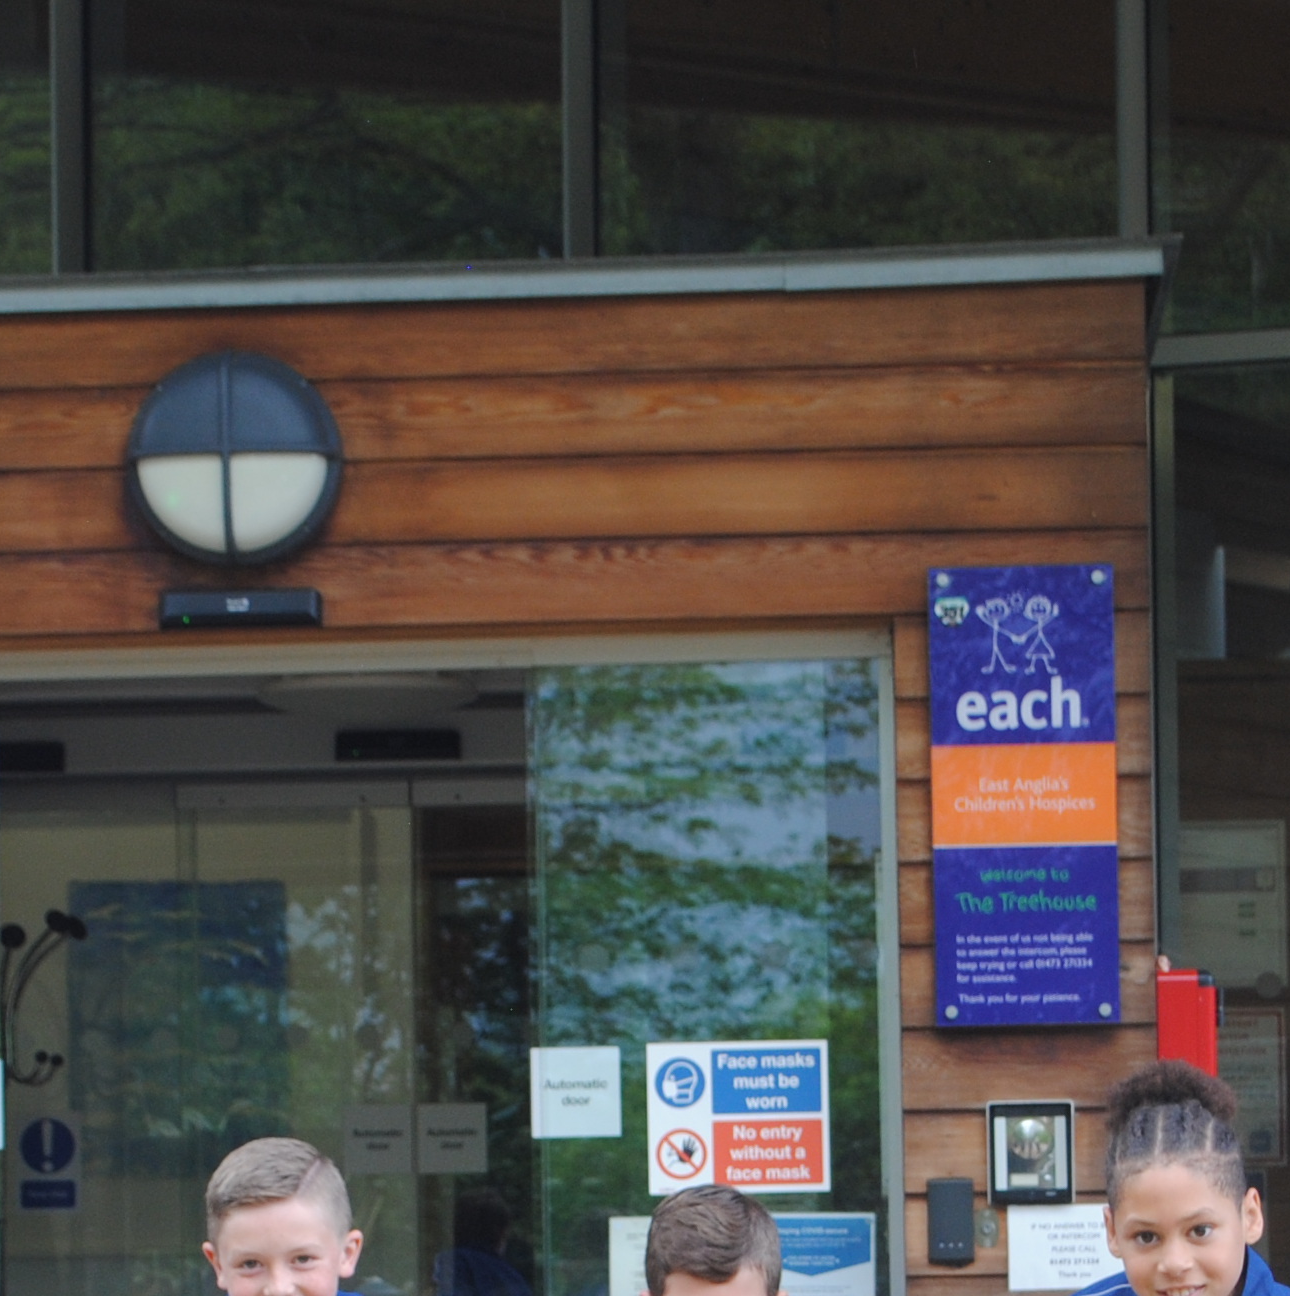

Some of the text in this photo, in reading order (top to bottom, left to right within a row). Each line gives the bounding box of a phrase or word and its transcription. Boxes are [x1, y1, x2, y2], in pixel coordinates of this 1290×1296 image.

[955, 675, 1082, 732] each
[978, 775, 1069, 795] East Anglia's
[954, 795, 1096, 815] Children's Hospices
[955, 888, 1098, 914] The Treehouse
[717, 1052, 815, 1070] Face masks
[544, 1078, 608, 1090] Automatic
[733, 1073, 800, 1090] must be
[561, 1093, 591, 1106] door
[745, 1095, 788, 1110] worn
[733, 1125, 803, 1143] No entry
[730, 1145, 806, 1161] without a
[727, 1166, 811, 1181] face mask
